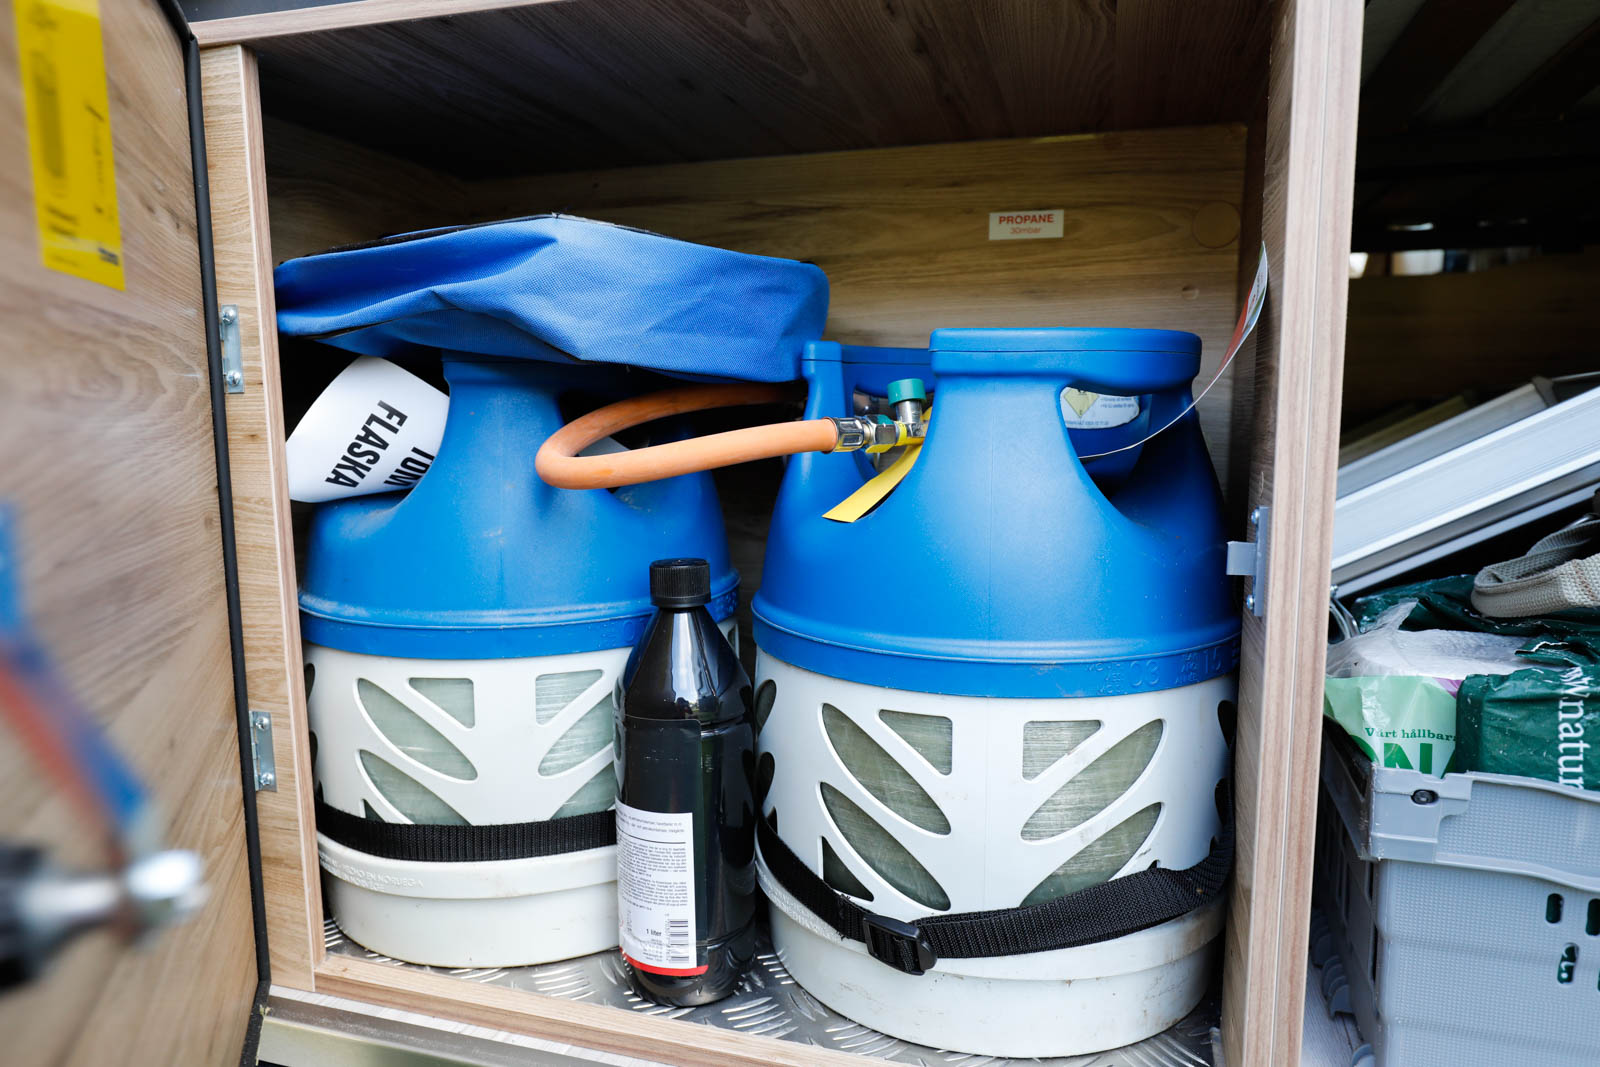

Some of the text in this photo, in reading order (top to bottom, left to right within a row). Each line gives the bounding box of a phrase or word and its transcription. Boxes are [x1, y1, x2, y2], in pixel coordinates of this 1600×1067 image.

[998, 213, 1054, 224] PROPANE
[325, 400, 408, 488] FLASKA
[650, 928, 662, 937] liter
